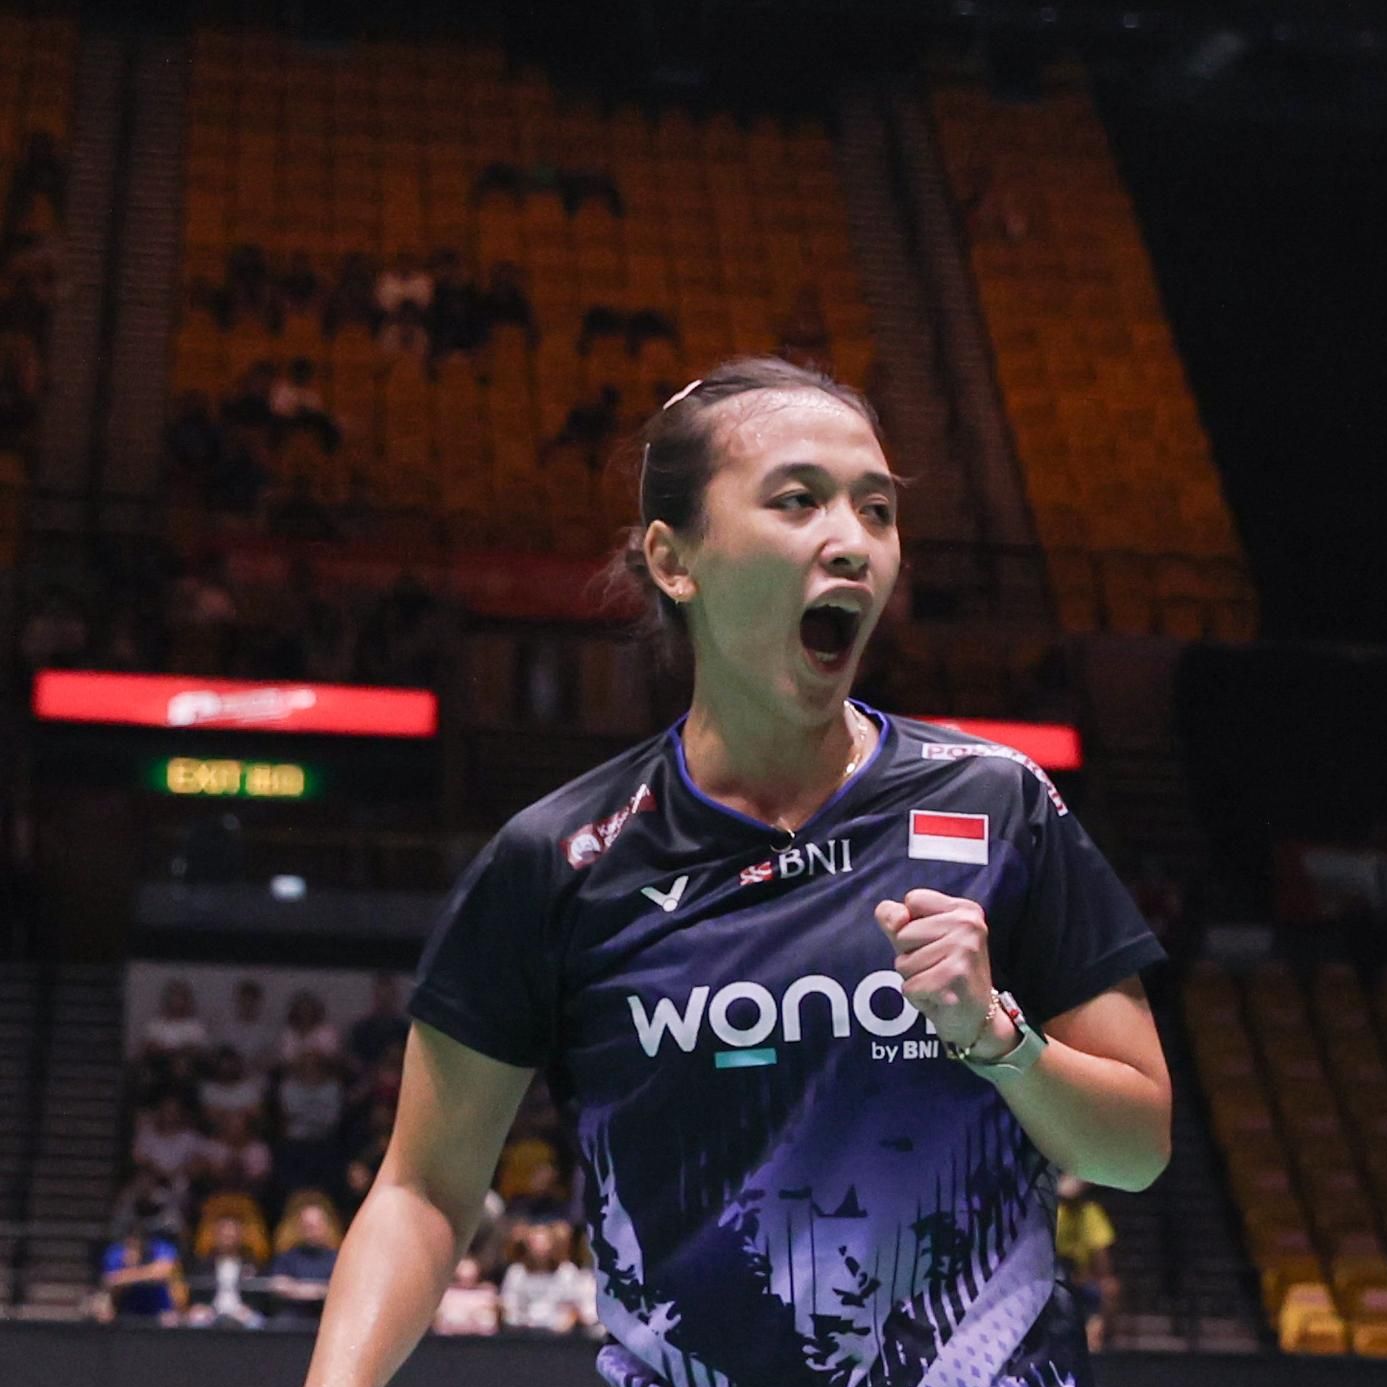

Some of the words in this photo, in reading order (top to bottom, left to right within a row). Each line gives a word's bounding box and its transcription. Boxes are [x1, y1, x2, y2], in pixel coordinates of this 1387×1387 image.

[167, 757, 241, 795] EXIT
[778, 838, 854, 879] BNI
[627, 968, 937, 1058] wond
[871, 1041, 898, 1063] by
[903, 1040, 939, 1060] BNI
